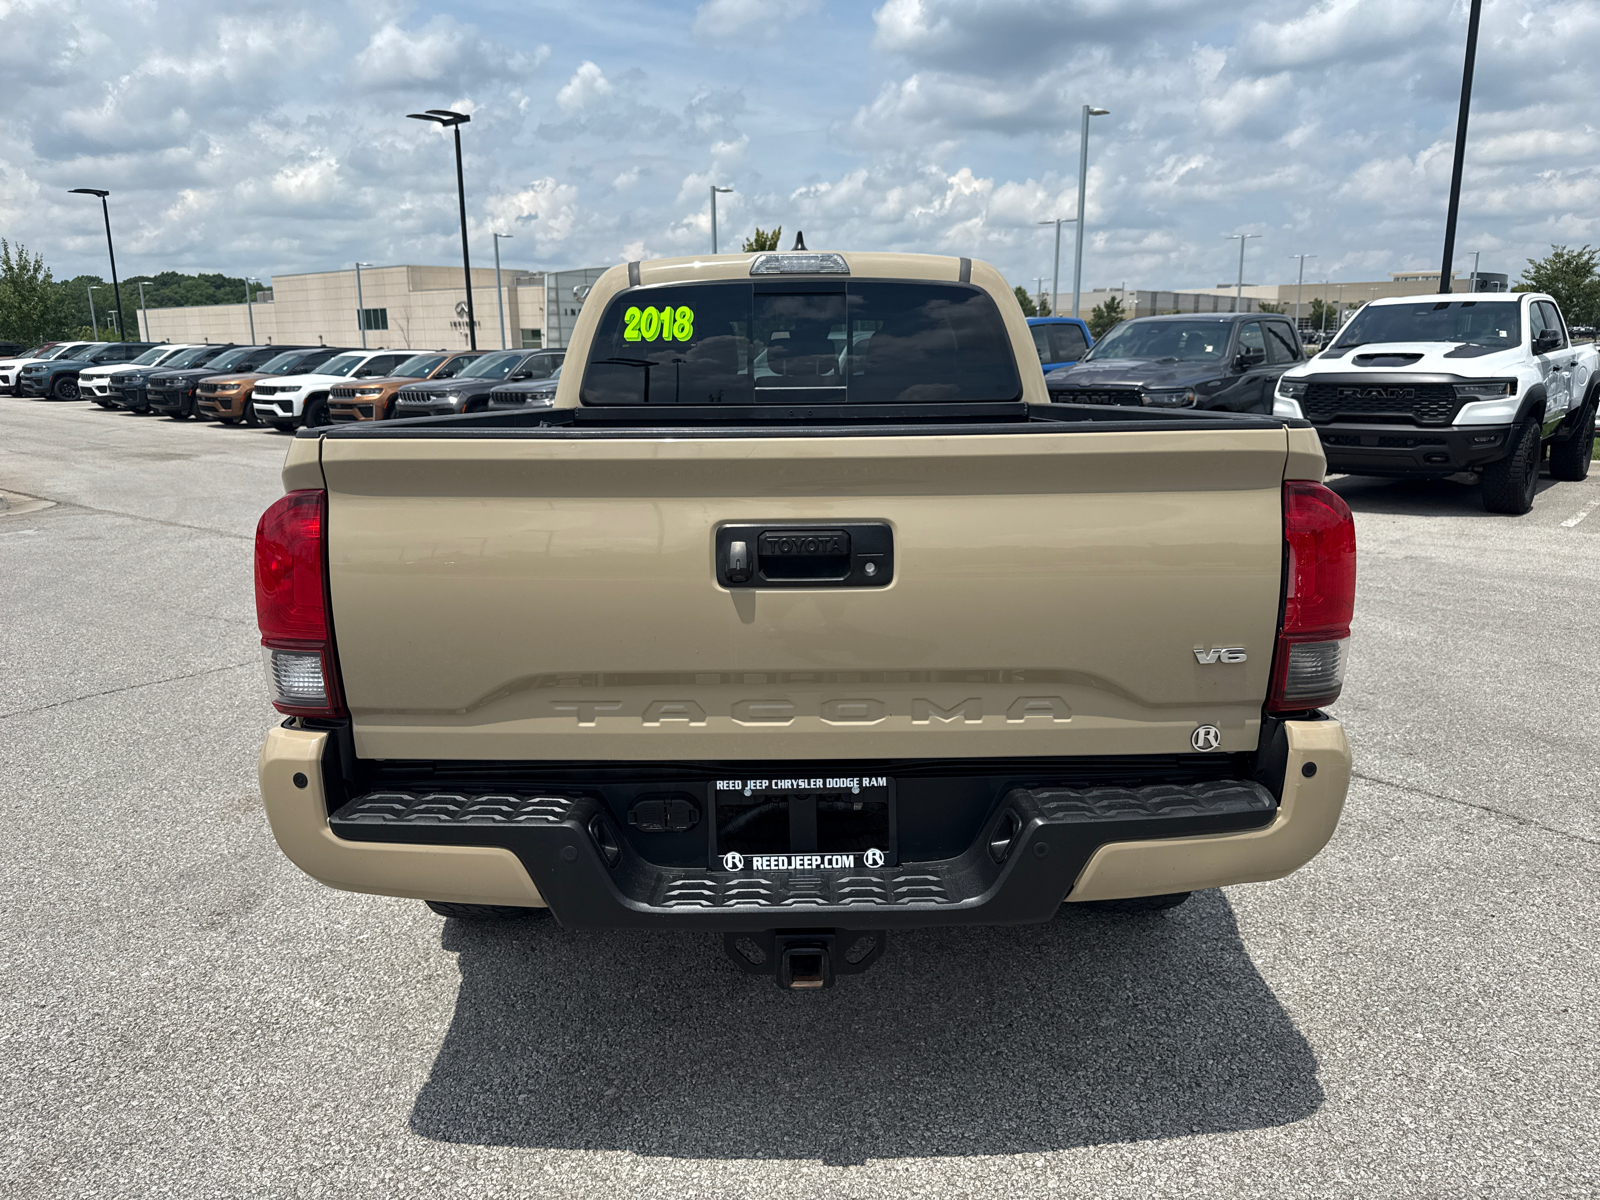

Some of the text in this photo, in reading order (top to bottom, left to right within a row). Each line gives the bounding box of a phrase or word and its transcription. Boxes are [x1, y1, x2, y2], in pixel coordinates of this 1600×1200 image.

[624, 306, 694, 342] 2018
[1057, 395, 1110, 404] RAM
[1337, 387, 1415, 398] RAM
[766, 537, 843, 554] TOYOTA
[1193, 647, 1247, 664] V6
[549, 696, 1073, 727] TACOMA
[1194, 726, 1220, 750] R
[716, 777, 887, 790] REED JEEP CHRYSLER DODGE RAM
[752, 855, 855, 870] REEDJEEP.COM
